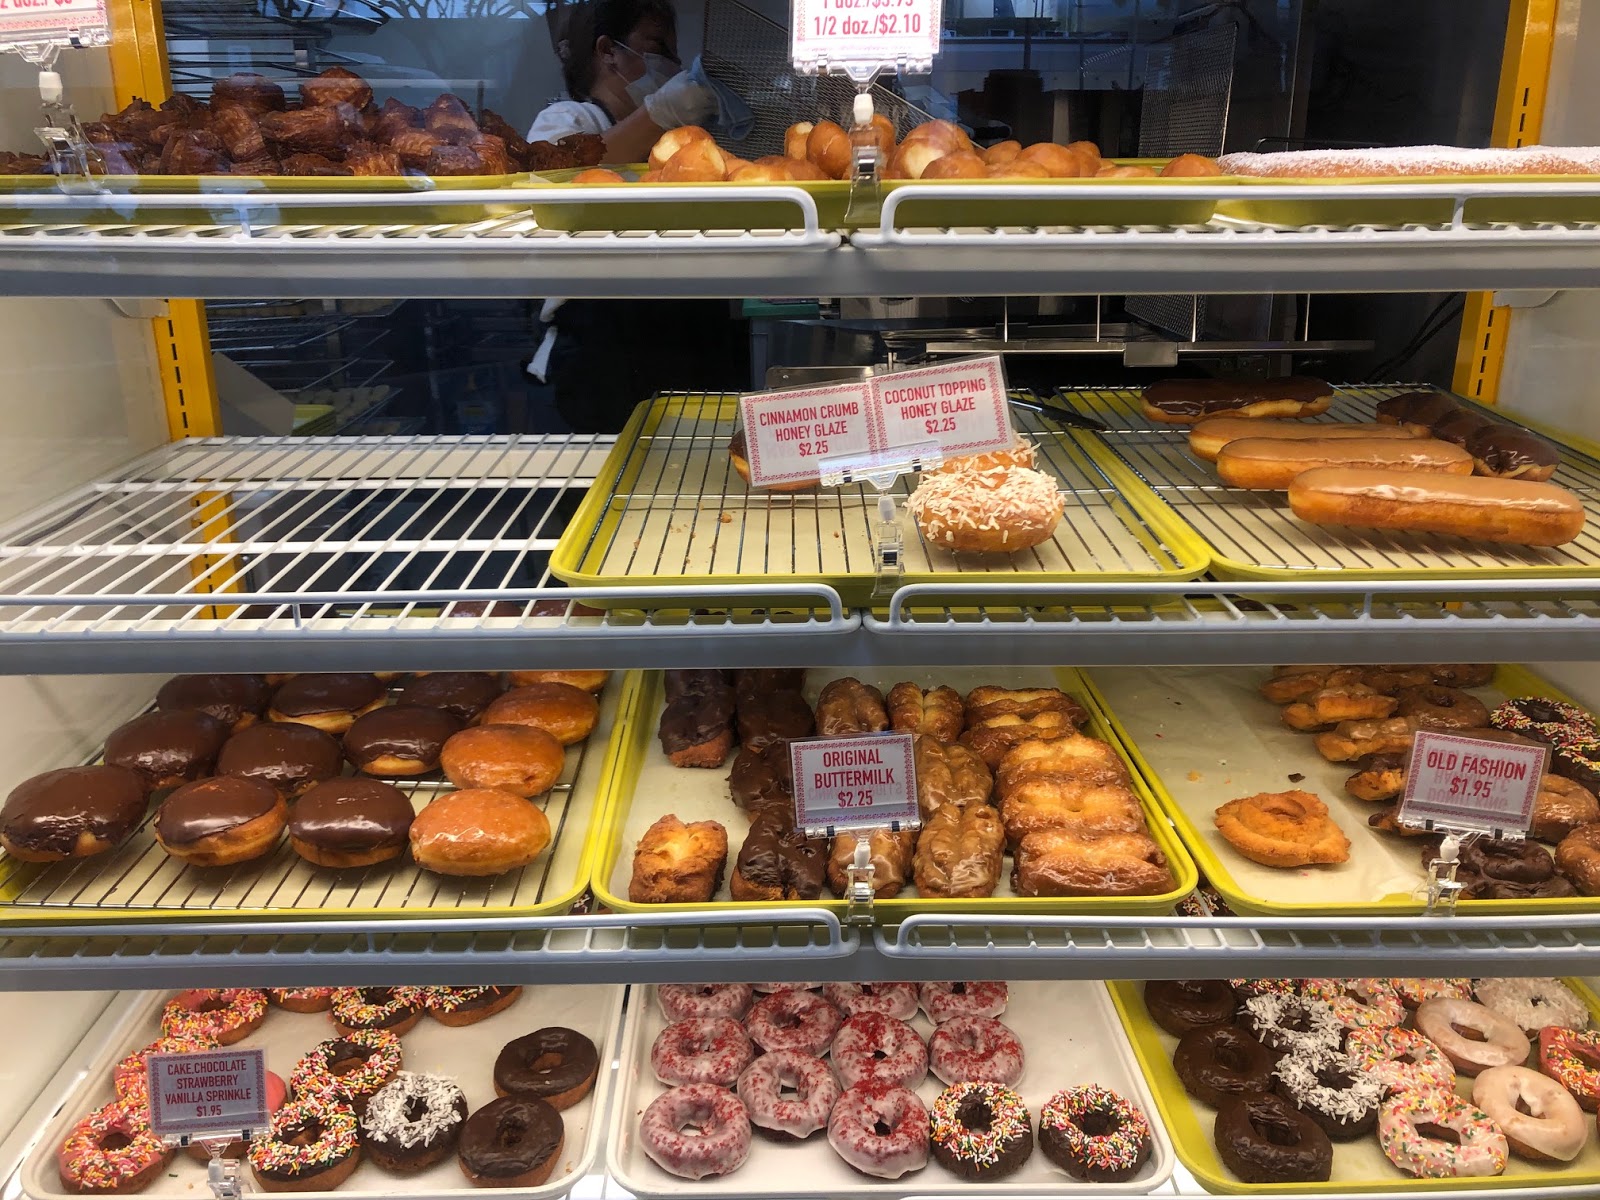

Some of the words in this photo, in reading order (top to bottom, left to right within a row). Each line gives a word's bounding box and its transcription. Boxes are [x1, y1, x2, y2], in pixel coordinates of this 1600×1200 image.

[815, 16, 837, 35] 1/2
[843, 13, 921, 35] doz./$2.10
[884, 385, 935, 404] COCONUT
[938, 378, 986, 396] TOPPING
[760, 407, 817, 426] CINNAMON
[820, 402, 859, 419] CRUMB
[901, 402, 937, 420] HONEY
[941, 397, 976, 413] GLAZE
[775, 425, 811, 442] HONEY
[814, 421, 848, 437] GLAZE
[925, 417, 956, 434] $2.25
[799, 440, 828, 457] $2.25
[823, 748, 883, 767] ORIGINAL
[1427, 751, 1457, 771] OLD
[1461, 756, 1527, 780] FASHION
[814, 768, 895, 789] BUTTERMILK
[1450, 776, 1492, 798] $1.95
[838, 790, 873, 808] $2.25
[177, 1074, 238, 1089] STRAWBERRY
[165, 1091, 204, 1105] VANILLA
[206, 1088, 252, 1102] SPRINKLE
[196, 1105, 222, 1117] $1.95
